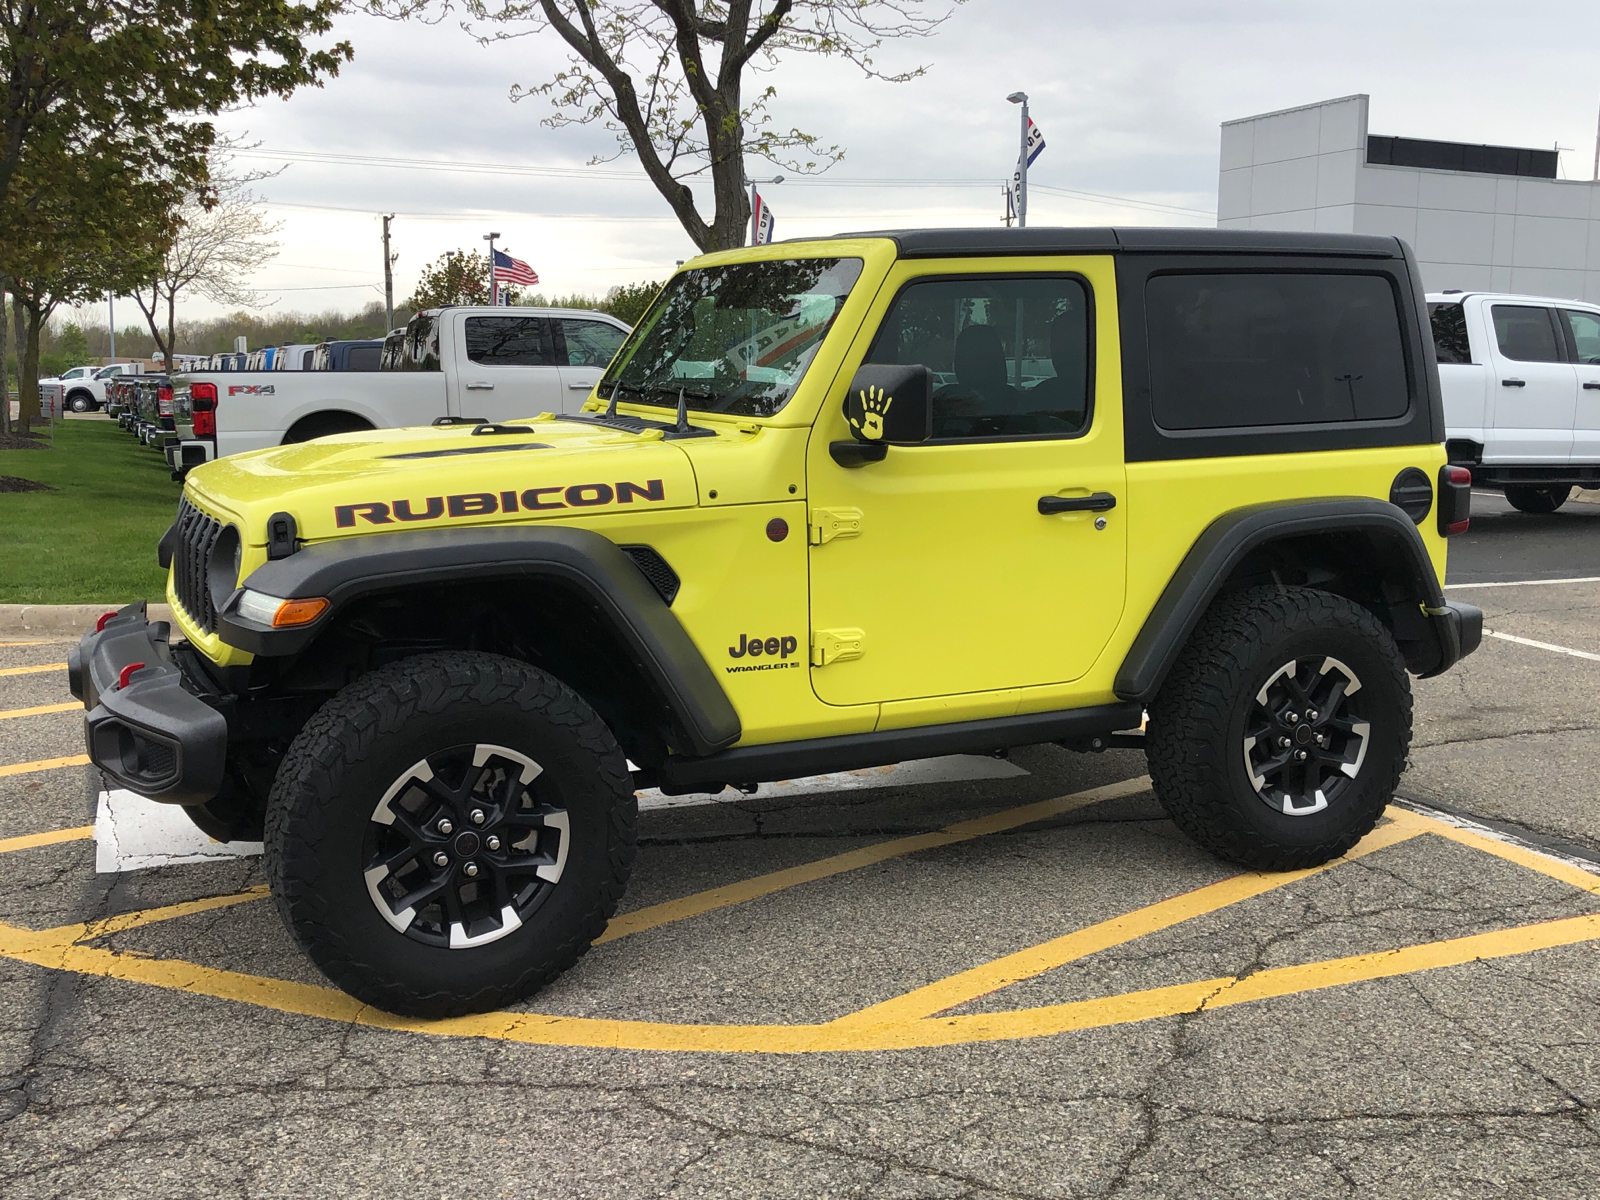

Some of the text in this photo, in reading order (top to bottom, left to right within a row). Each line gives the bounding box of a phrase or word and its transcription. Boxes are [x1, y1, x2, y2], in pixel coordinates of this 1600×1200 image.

[228, 385, 275, 396] FX4
[335, 479, 665, 529] RUBICON
[728, 633, 798, 659] Jeep
[726, 662, 788, 673] WRANGLER
